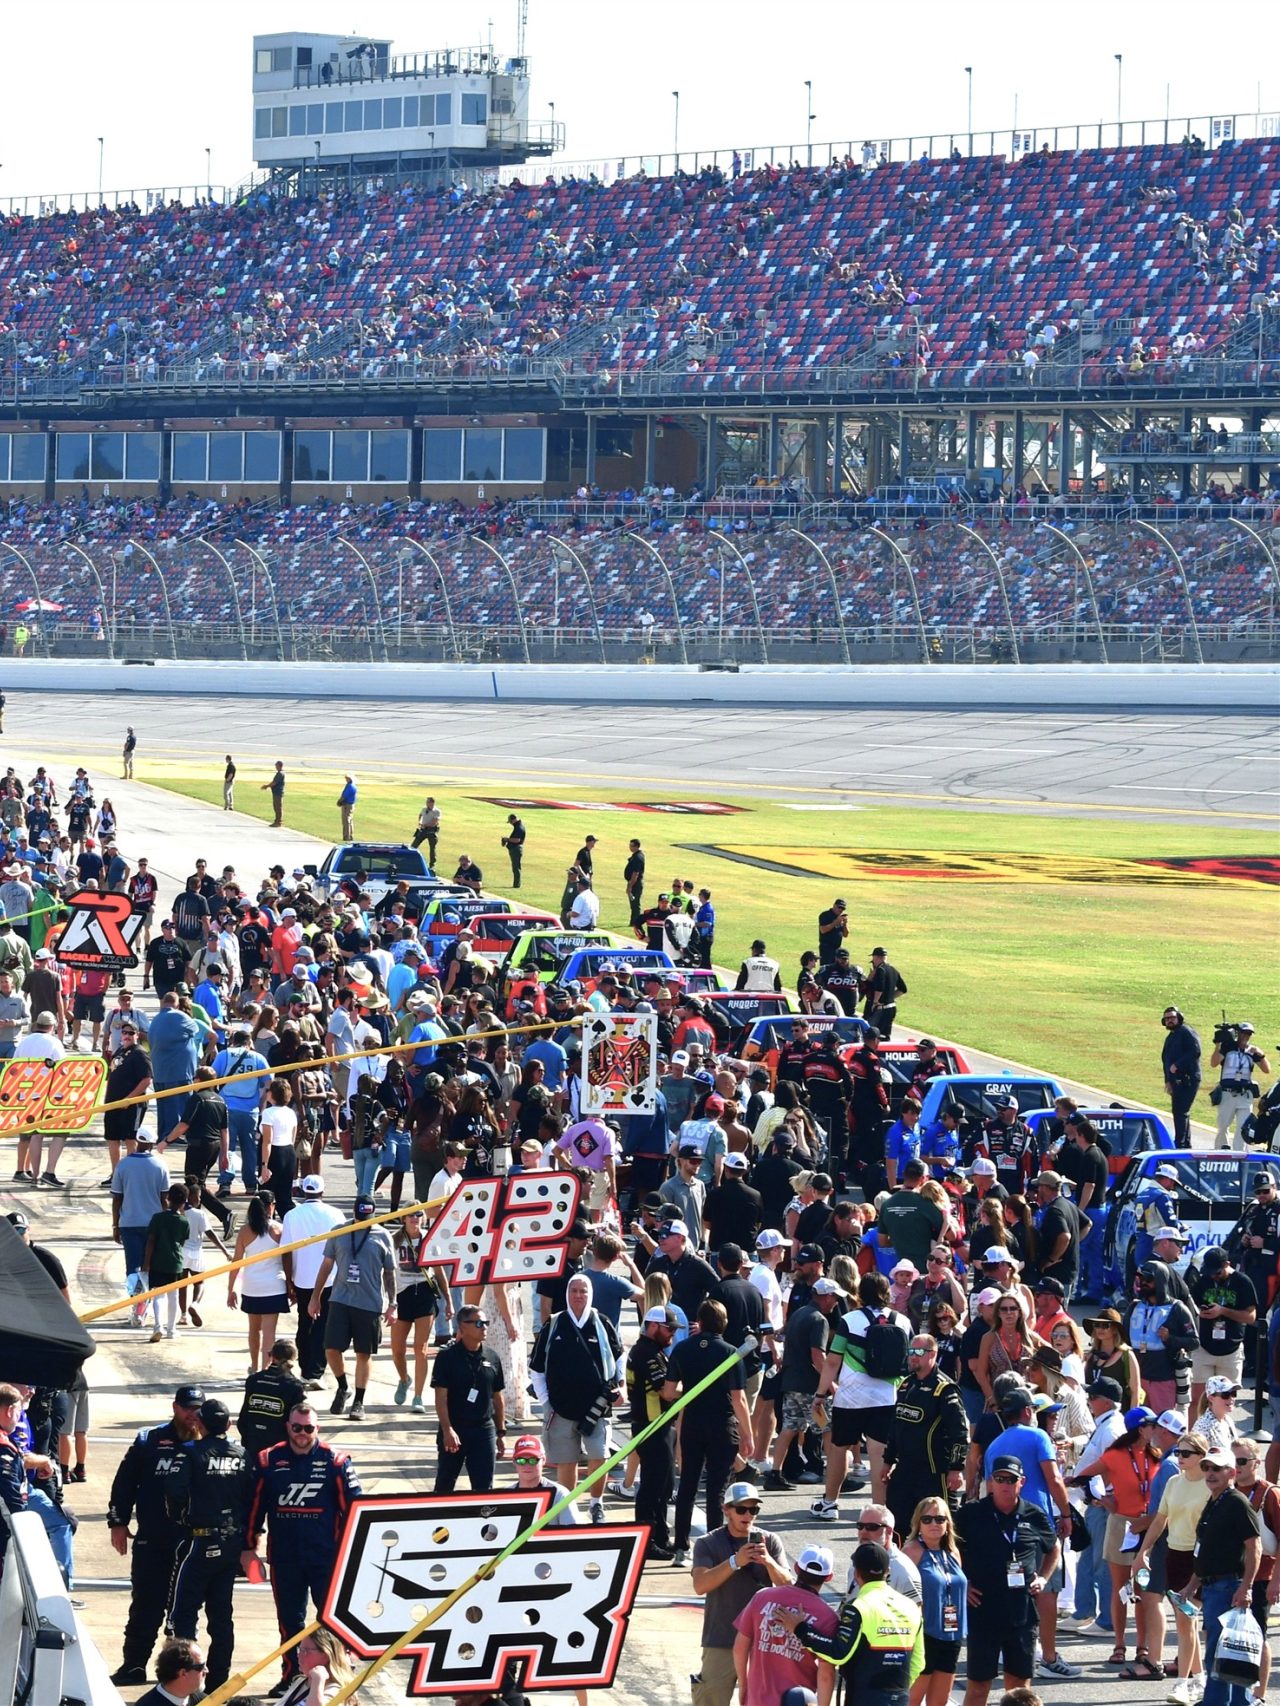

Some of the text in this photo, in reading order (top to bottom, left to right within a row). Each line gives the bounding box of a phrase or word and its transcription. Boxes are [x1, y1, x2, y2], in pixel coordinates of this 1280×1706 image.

[507, 919, 526, 927] HEIM
[59, 953, 103, 964] RACKLEY
[827, 977, 859, 987] FORD
[727, 1000, 760, 1010] RHODES
[807, 1022, 834, 1032] KRUM
[885, 1051, 920, 1062] HOLME
[985, 1083, 1013, 1094] GRAY
[1088, 1119, 1124, 1131] RUTH
[1198, 1161, 1240, 1173] SUTTON
[418, 1174, 579, 1285] 42
[207, 1457, 246, 1471] NIECE
[278, 1483, 324, 1507] J.F.
